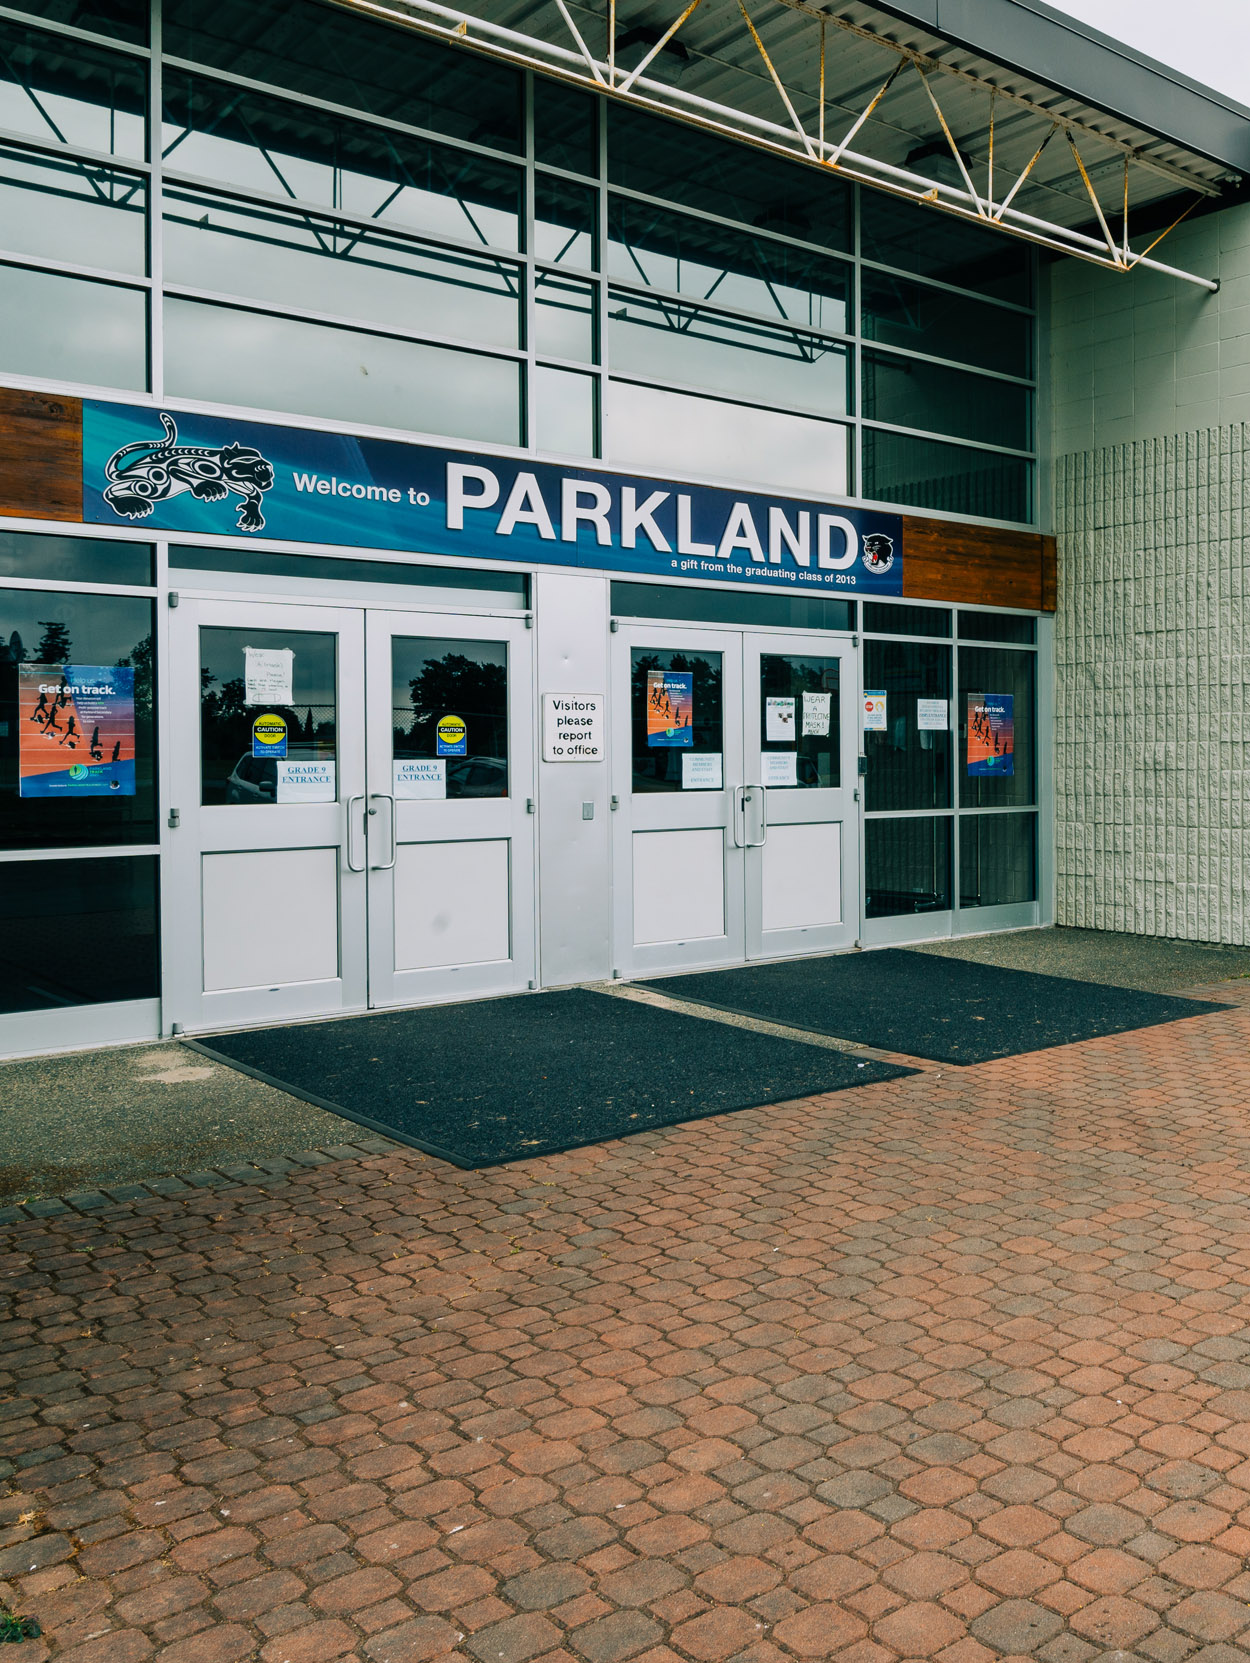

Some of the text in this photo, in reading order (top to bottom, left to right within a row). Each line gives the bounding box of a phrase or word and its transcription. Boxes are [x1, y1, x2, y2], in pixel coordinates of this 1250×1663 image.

[292, 472, 431, 506] Welcome to
[446, 461, 859, 570] PARKLAND
[671, 559, 857, 585] a gift from the graduating class of 2013
[38, 684, 116, 695] Get on track.
[672, 682, 688, 690] track.
[552, 699, 596, 711] Visitors
[803, 695, 826, 704] WEAR
[974, 705, 984, 713] Get
[992, 706, 1006, 714] track.
[557, 715, 593, 728] please
[558, 731, 592, 742] report
[552, 744, 598, 755] to office
[287, 766, 327, 774] GRADE 9
[402, 764, 438, 772] GRADE 9
[282, 775, 332, 784] ENTRANCE
[397, 773, 443, 781] ENTRANCE
